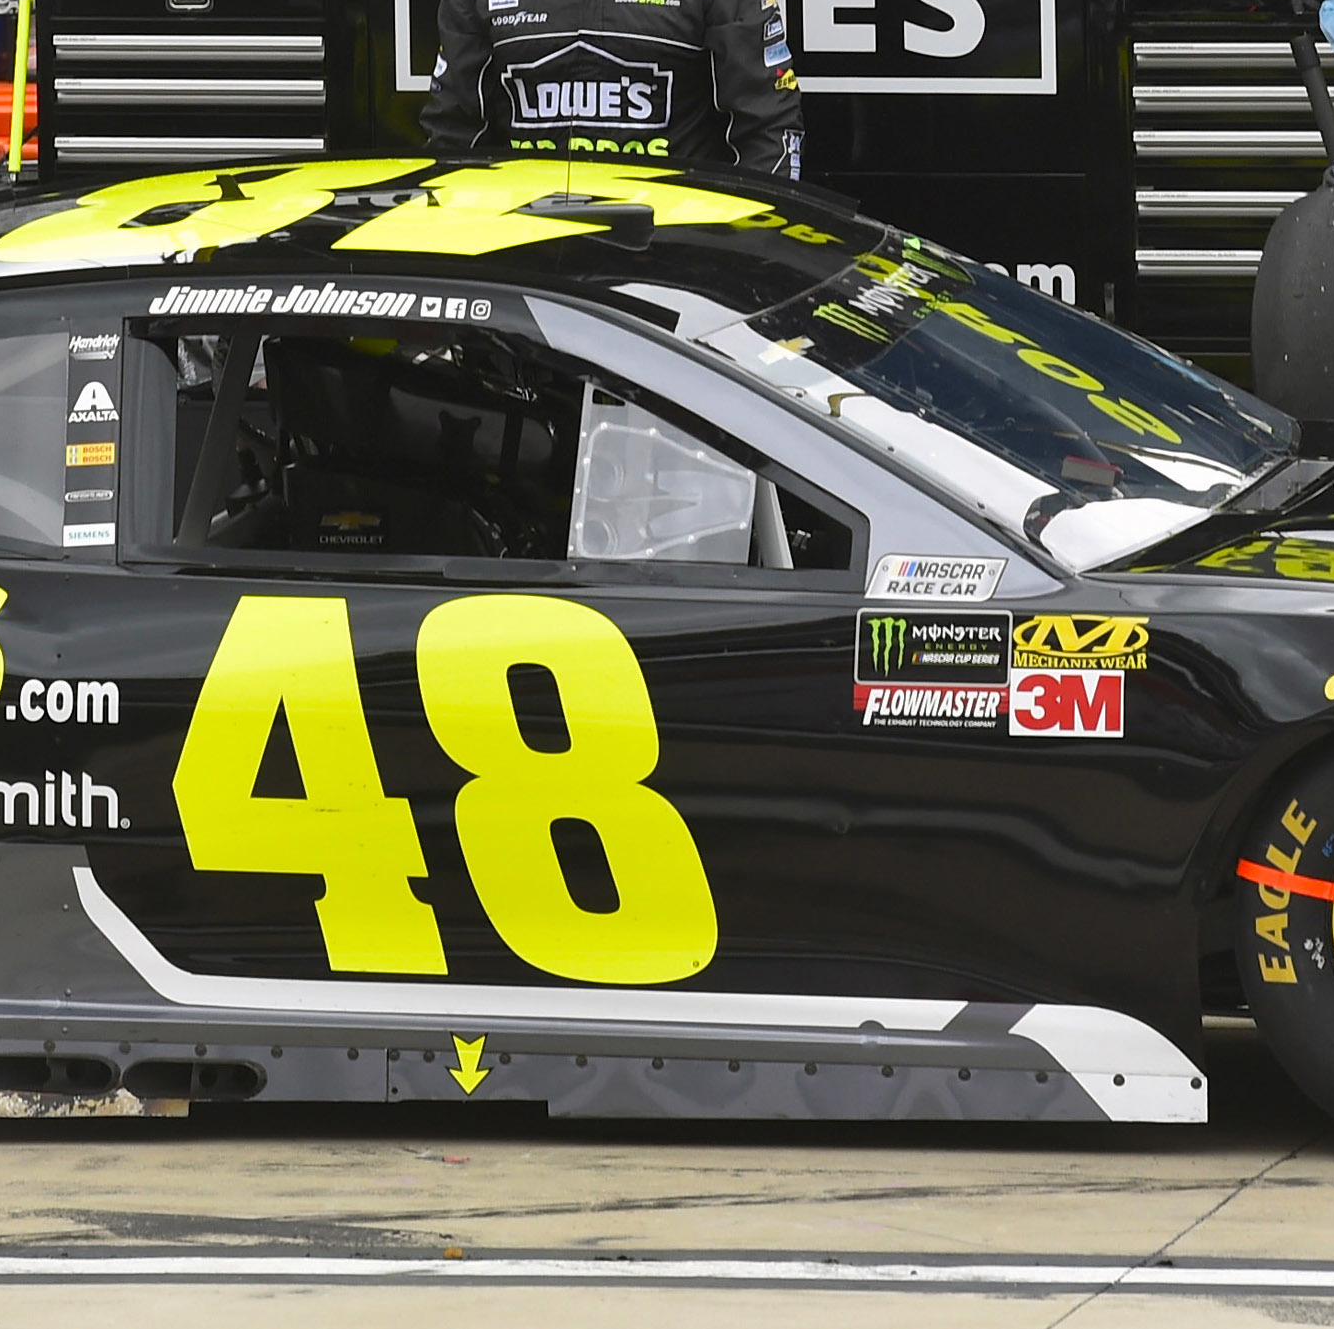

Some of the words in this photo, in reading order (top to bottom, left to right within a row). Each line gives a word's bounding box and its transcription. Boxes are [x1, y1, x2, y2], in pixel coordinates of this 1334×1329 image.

[513, 75, 653, 120] LOWE'S
[148, 284, 268, 315] Jimmie
[271, 282, 418, 318] Johnson
[69, 332, 120, 353] Hendrick
[68, 409, 120, 422] AXALTA
[82, 445, 112, 454] BOSCH
[82, 454, 112, 463] BOSCH
[68, 530, 110, 541] SIEMENS
[318, 534, 384, 544] CHEVROLET
[914, 561, 985, 579] NASCAR
[886, 581, 933, 595] RACE
[939, 582, 977, 596] CAR
[911, 623, 1002, 642] MONSTER
[924, 643, 989, 651] ENERGY
[921, 653, 953, 664] NASCAR
[954, 653, 971, 665] CUP
[1013, 649, 1098, 669] MECHANIX
[1099, 651, 1149, 670] WEAR
[862, 687, 1002, 726] FLOWMASTER
[1014, 673, 1123, 733] 3M
[171, 593, 719, 985] 48
